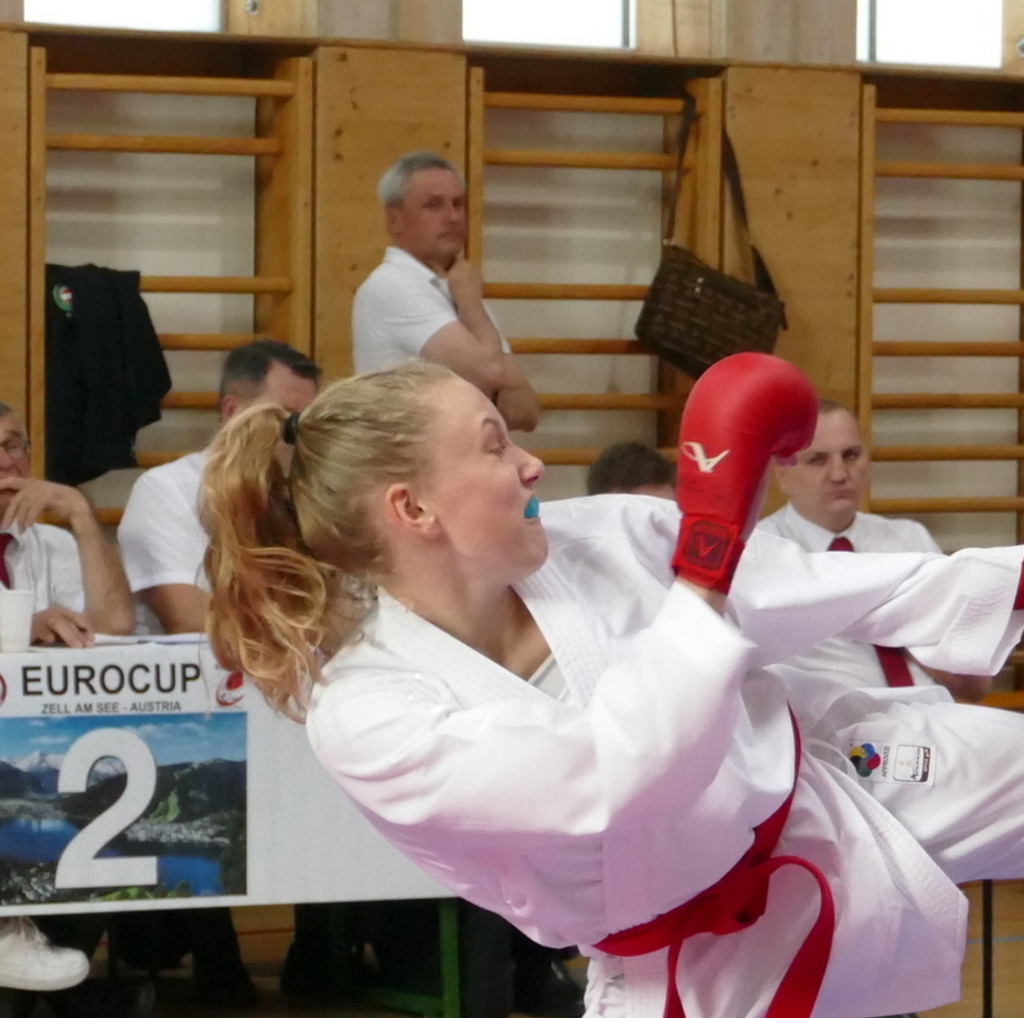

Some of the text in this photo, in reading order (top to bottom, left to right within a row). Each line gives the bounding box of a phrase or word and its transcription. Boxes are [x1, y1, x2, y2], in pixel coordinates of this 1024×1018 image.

[21, 663, 201, 696] EUROCUP
[41, 702, 71, 715] ZELL
[75, 702, 93, 714] AM
[98, 702, 119, 713] SEE
[129, 701, 182, 713] AUSTRIA
[55, 727, 158, 889] 2
